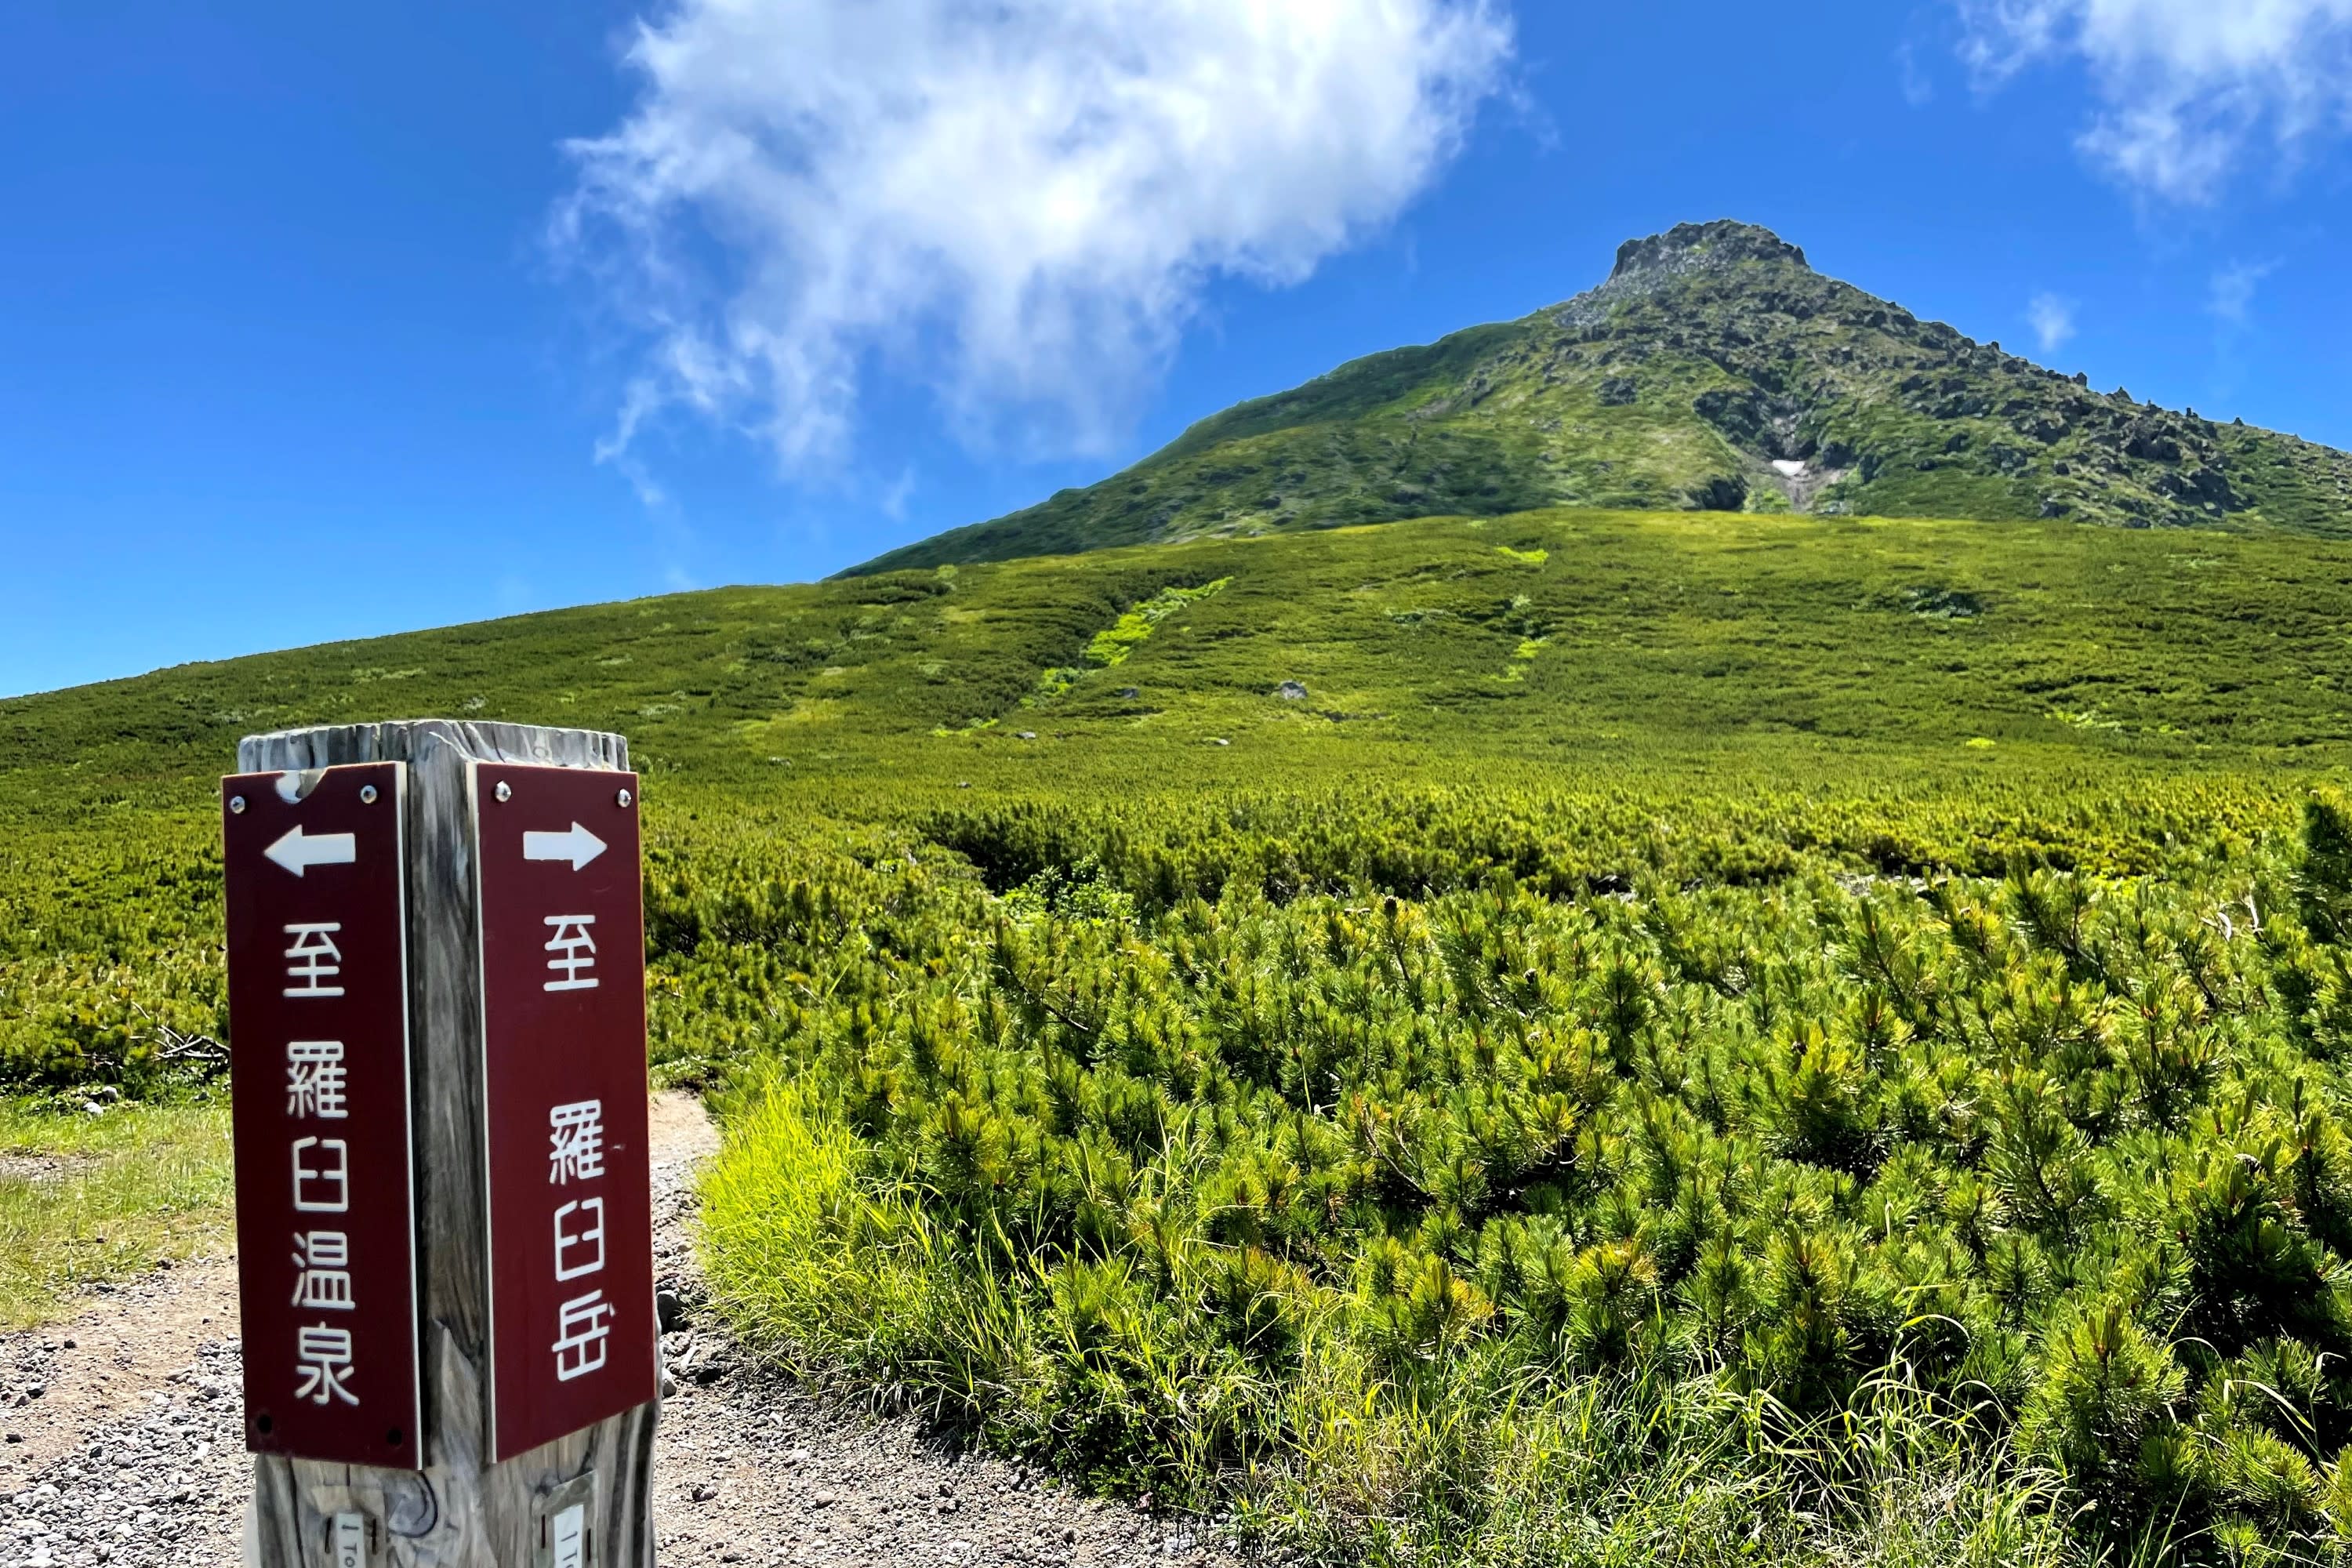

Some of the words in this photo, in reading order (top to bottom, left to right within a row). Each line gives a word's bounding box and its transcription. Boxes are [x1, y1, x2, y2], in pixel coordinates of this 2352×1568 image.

[283, 922, 345, 997] 至
[543, 914, 600, 992] 至
[287, 1040, 360, 1406] 羅臼温泉
[549, 1098, 616, 1382] 羅臼岳
